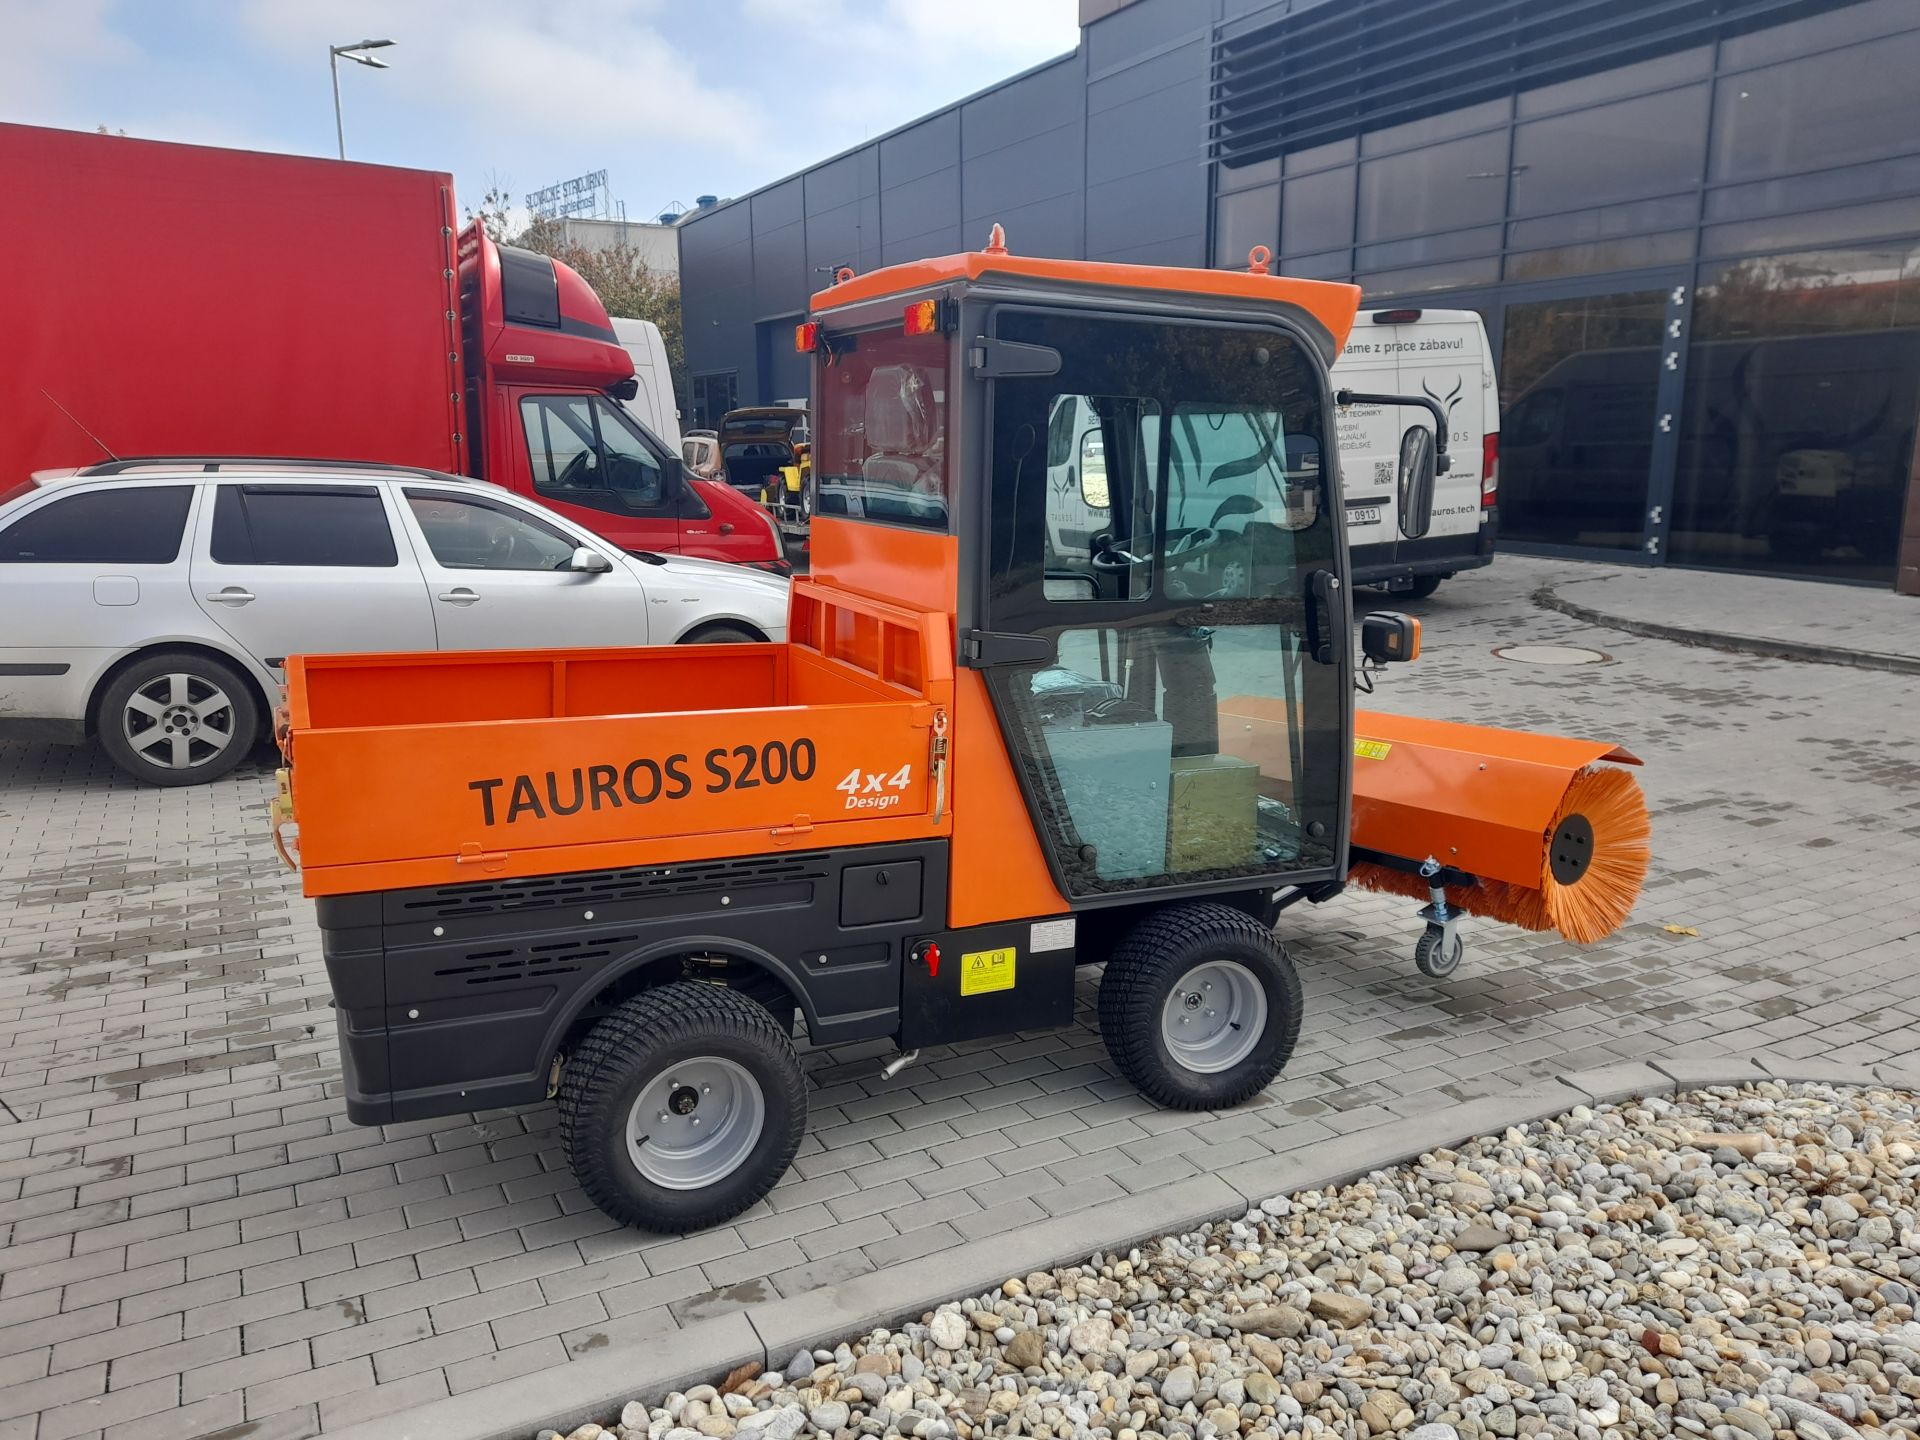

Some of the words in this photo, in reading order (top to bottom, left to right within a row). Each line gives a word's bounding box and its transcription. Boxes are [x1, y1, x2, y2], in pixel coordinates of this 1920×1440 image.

[1374, 344, 1382, 353] z
[1420, 337, 1464, 351] zábavu!
[1354, 509, 1376, 520] 0913
[1431, 504, 1475, 516] auros.tech
[468, 753, 691, 826] TAUROS
[704, 737, 817, 794] S200
[836, 764, 911, 794] 4x4
[845, 794, 899, 810] Design
